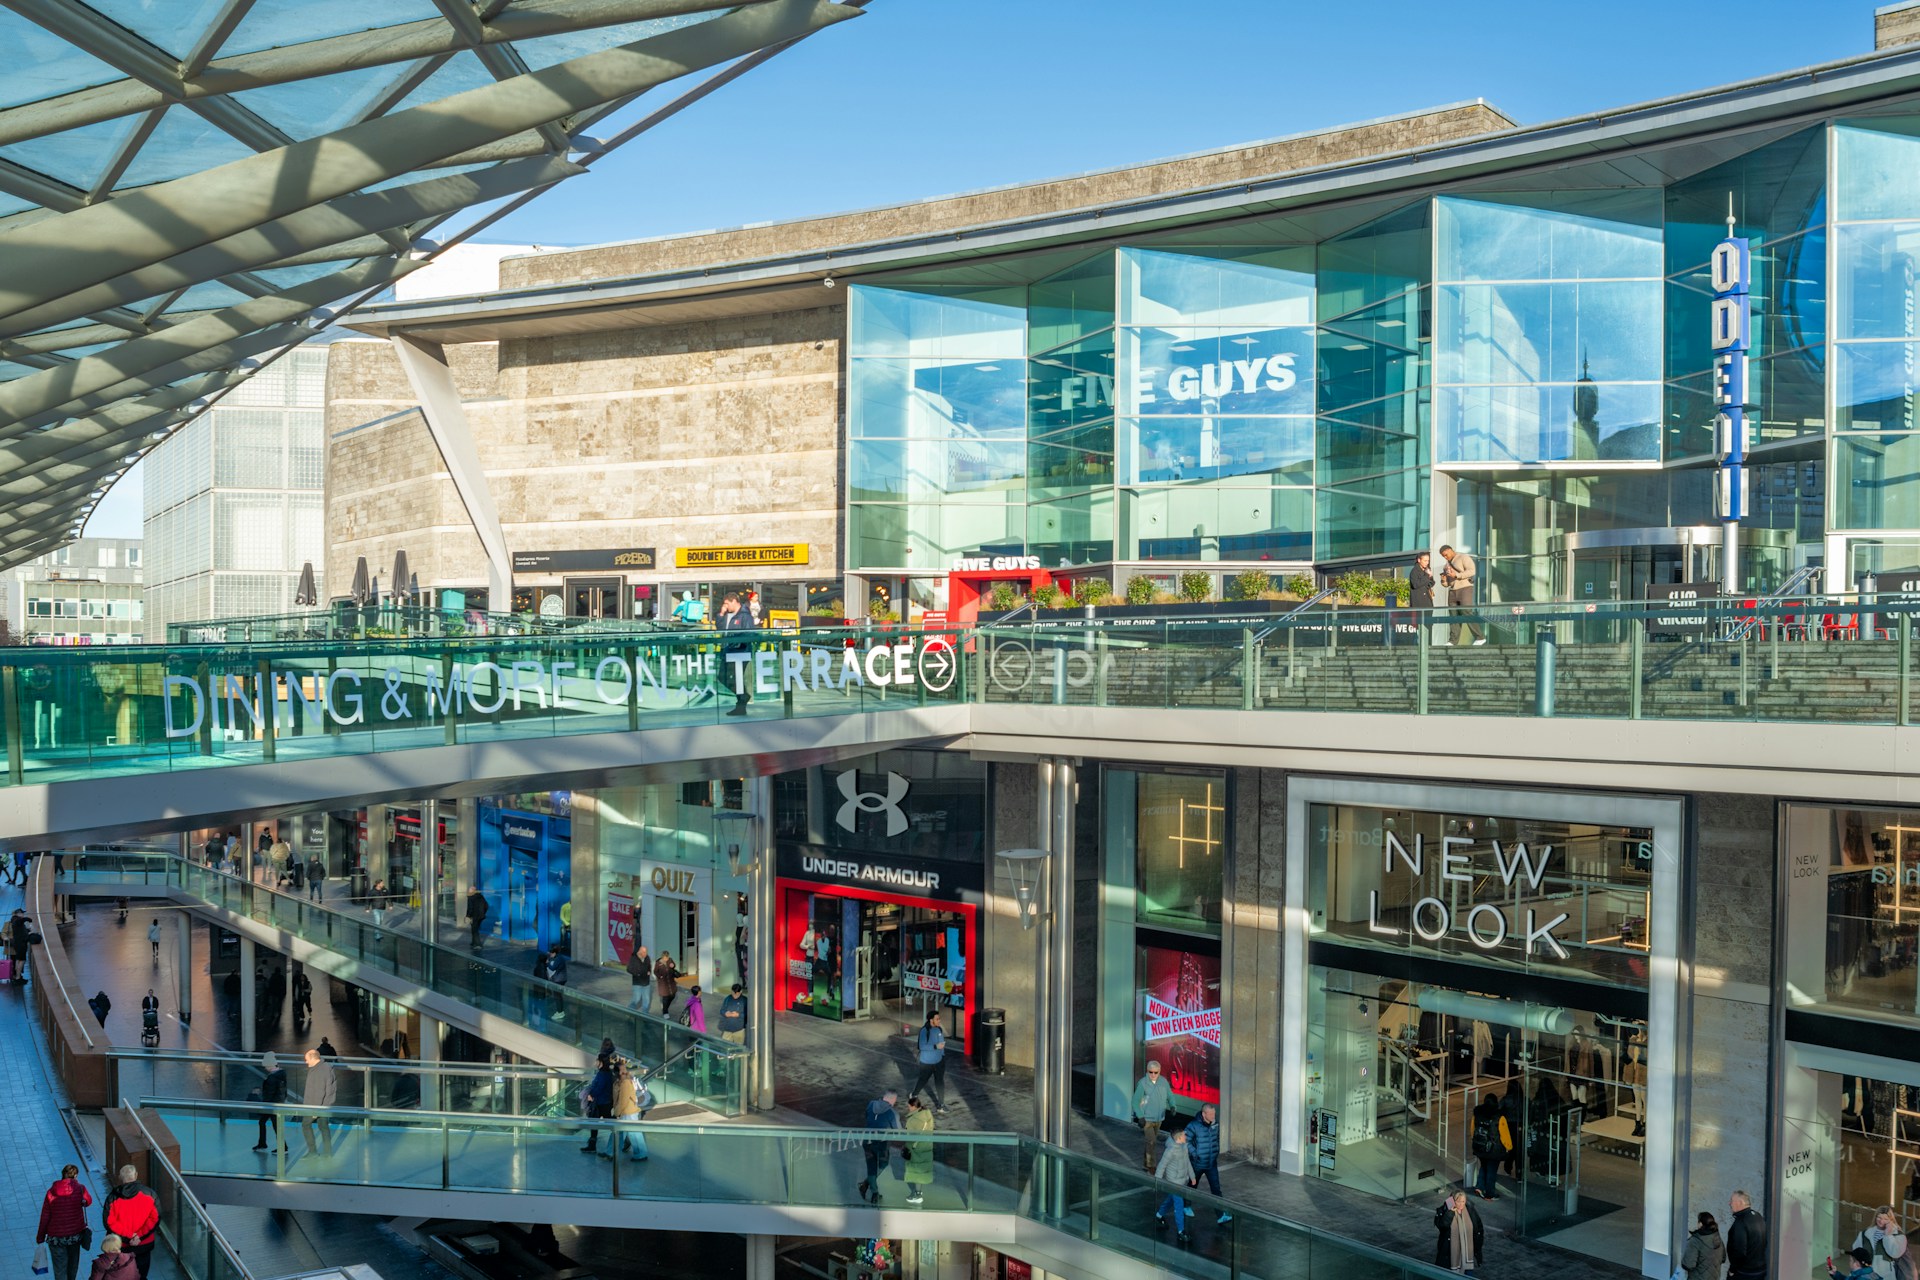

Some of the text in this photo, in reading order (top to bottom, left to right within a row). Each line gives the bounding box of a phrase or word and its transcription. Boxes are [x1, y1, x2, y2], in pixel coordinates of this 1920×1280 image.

[1061, 355, 1296, 410] FIVE GUYS
[1711, 241, 1742, 518] ODEON
[687, 549, 795, 561] GOURMET BURGER KITCHEN
[952, 555, 1040, 572] FIVE GUYS
[1668, 591, 1697, 608] SLIM
[1342, 624, 1382, 632] FIVE GUYS
[162, 668, 364, 738] DINING
[381, 666, 412, 720] &
[425, 661, 580, 716] MORE
[595, 655, 668, 705] ON
[672, 654, 716, 676] THE
[725, 644, 915, 695] TERRACE
[1386, 830, 1553, 890] NEW
[1796, 854, 1819, 866] NEW
[651, 866, 696, 896] QUIZ
[802, 856, 940, 890] UNDER ARMOUR
[1794, 866, 1820, 879] LOOK
[612, 902, 630, 915] SALE
[610, 920, 633, 940] 70%
[1370, 890, 1570, 960] LOOK
[1149, 999, 1169, 1018] NOW
[1151, 1017, 1171, 1037] NOW
[1172, 1014, 1193, 1033] EVEN
[1788, 1149, 1811, 1165] NEW
[1785, 1162, 1812, 1179] LOOK
